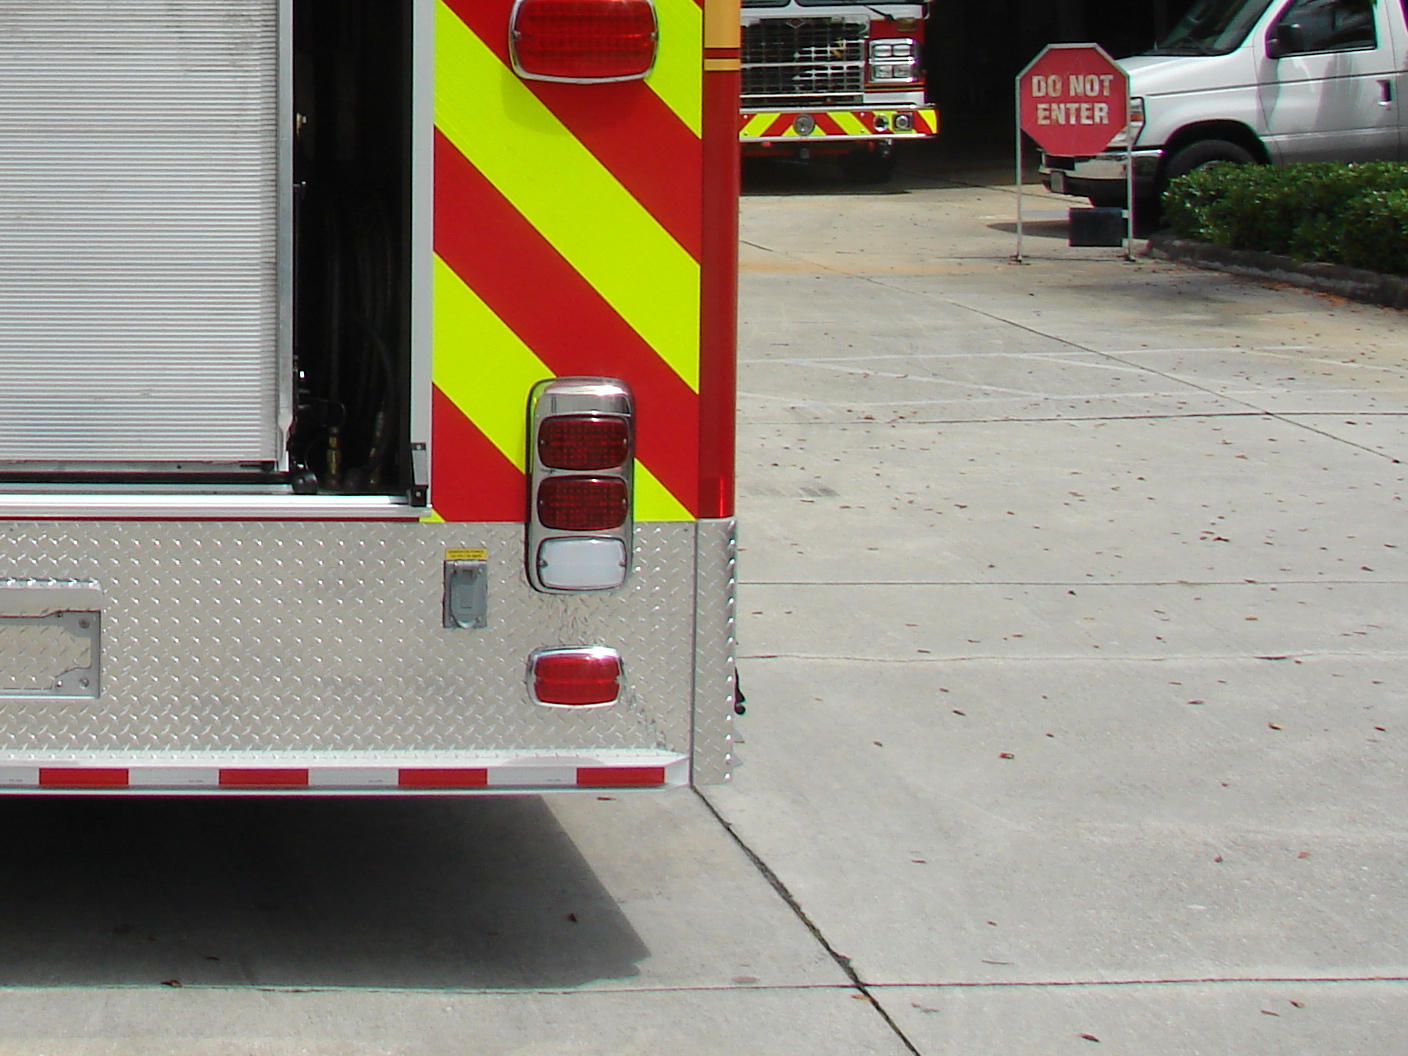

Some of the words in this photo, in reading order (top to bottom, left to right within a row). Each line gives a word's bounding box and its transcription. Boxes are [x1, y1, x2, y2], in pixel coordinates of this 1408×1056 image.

[1032, 75, 1062, 97] DO
[1069, 75, 1113, 97] NOT
[1037, 103, 1109, 125] ENTER
